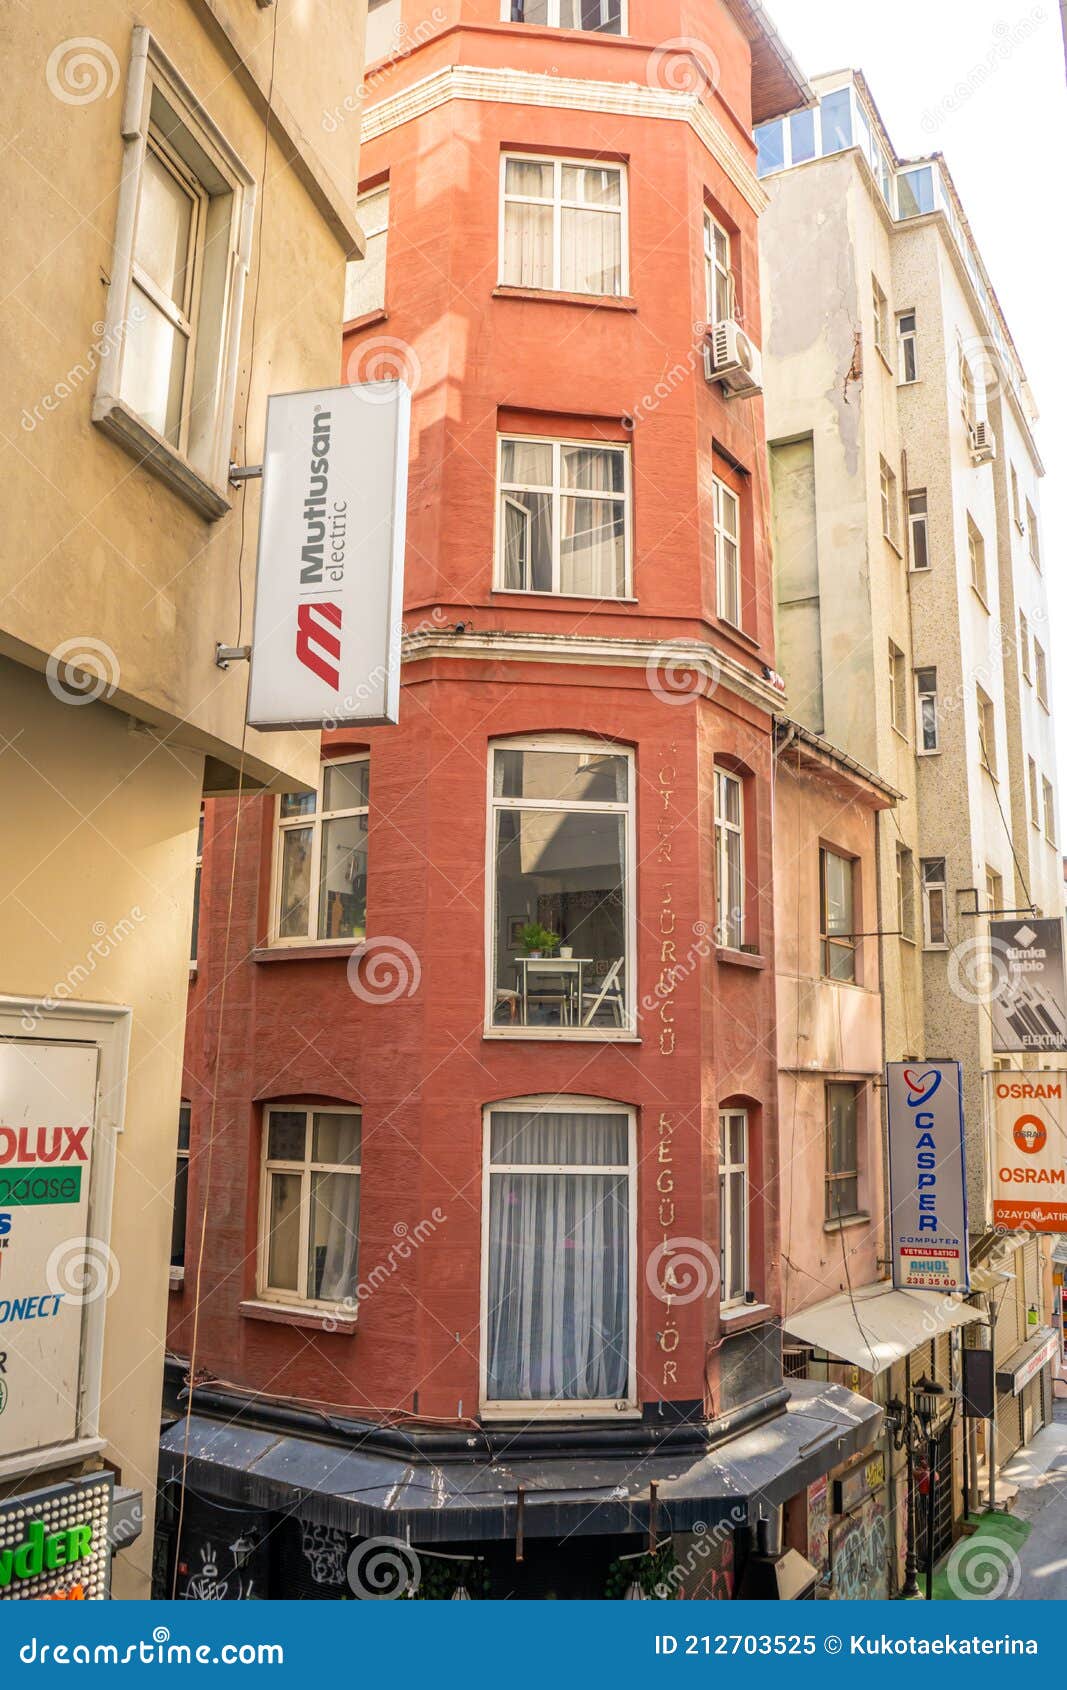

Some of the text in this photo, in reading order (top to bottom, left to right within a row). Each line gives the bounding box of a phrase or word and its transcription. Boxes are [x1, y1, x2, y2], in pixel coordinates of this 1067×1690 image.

[299, 411, 332, 585] Mutlusan
[326, 500, 348, 582] electric
[996, 1083, 1062, 1100] OSRAM
[914, 1112, 938, 1232] CASPER
[999, 1167, 1066, 1184] OSRAM
[900, 1236, 959, 1244] COMPUTER
[928, 1278, 940, 1286] 35
